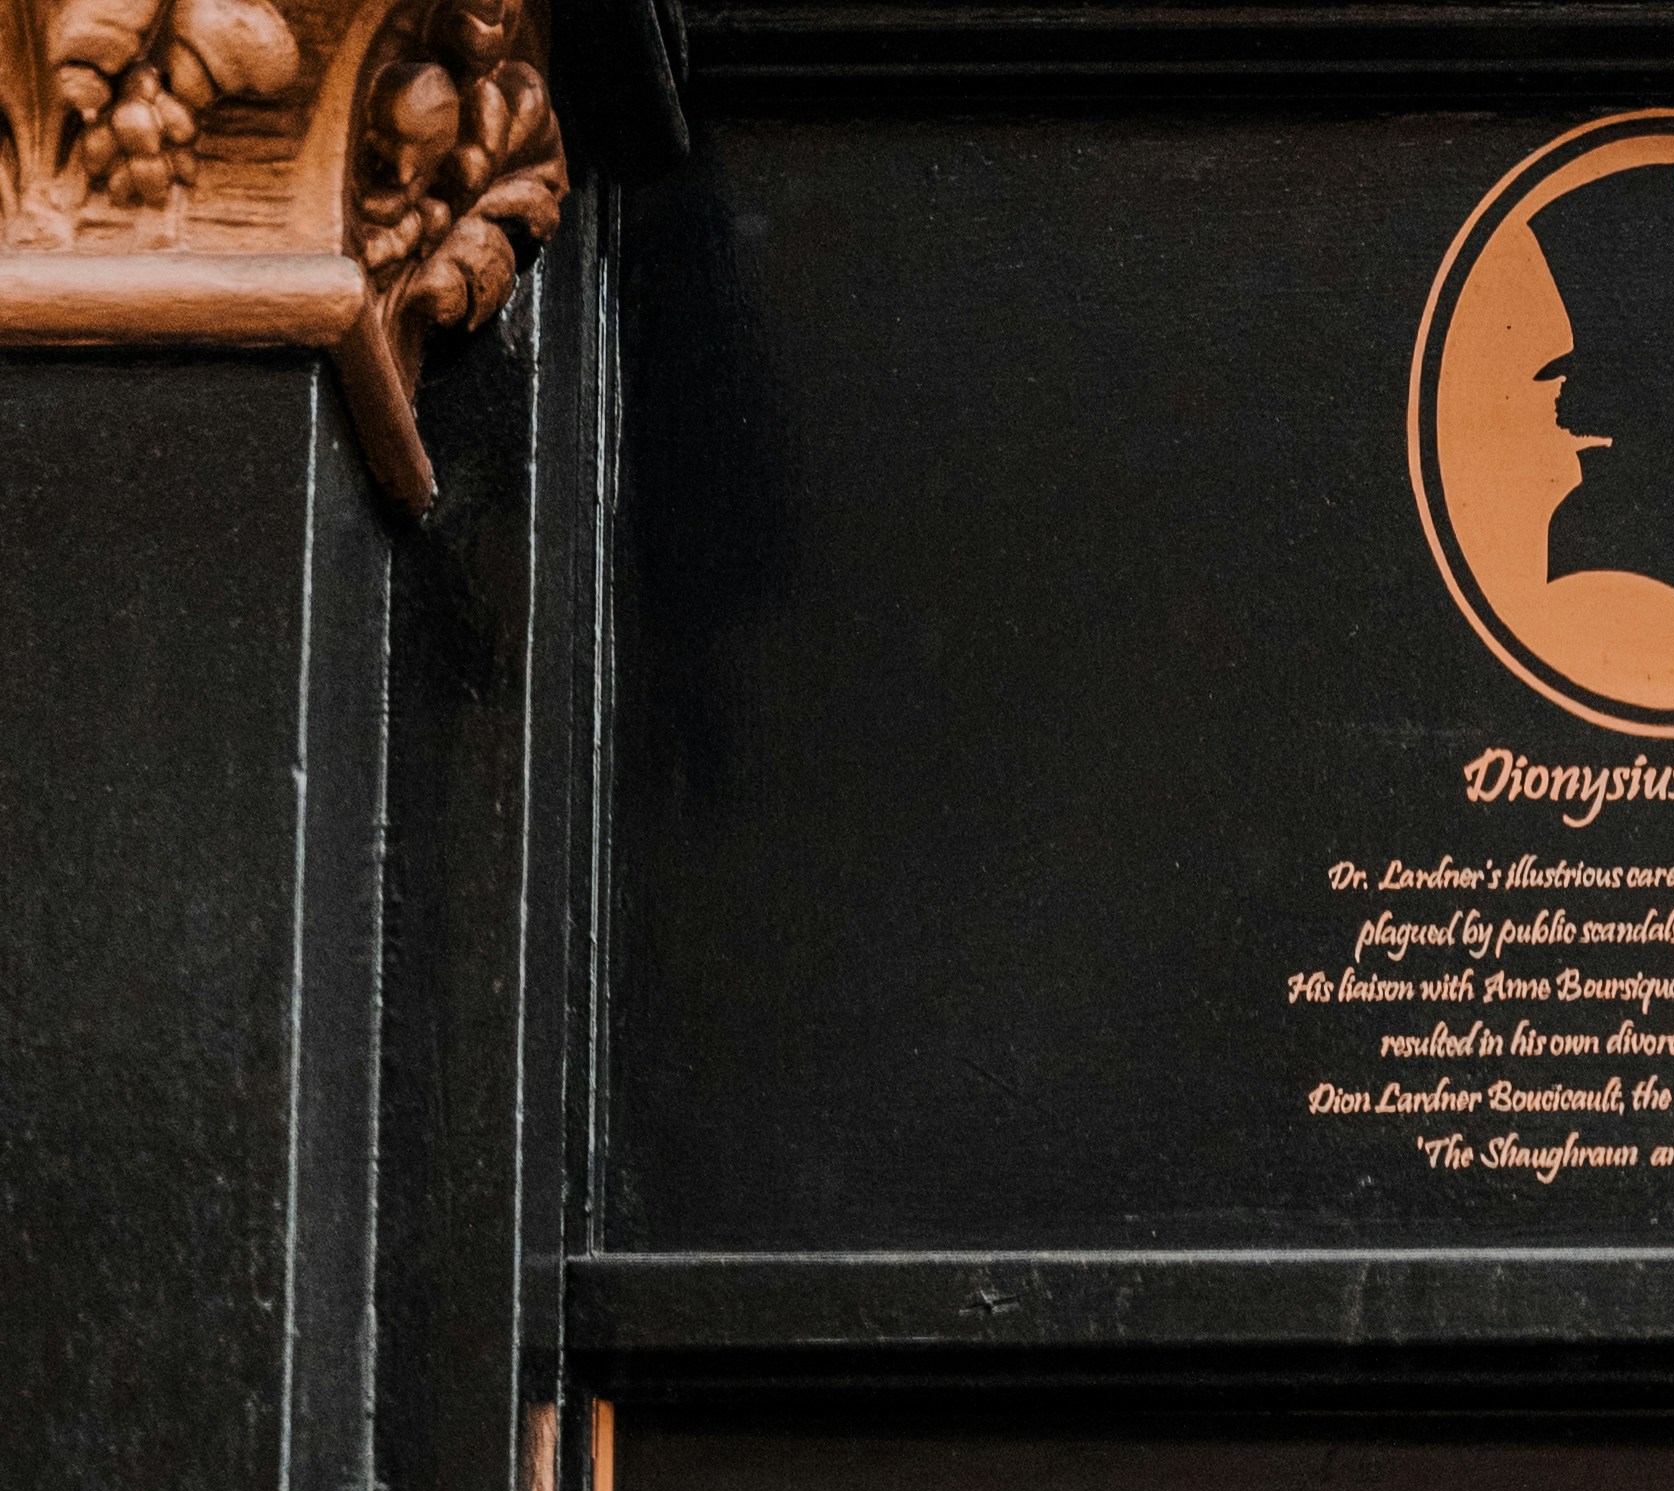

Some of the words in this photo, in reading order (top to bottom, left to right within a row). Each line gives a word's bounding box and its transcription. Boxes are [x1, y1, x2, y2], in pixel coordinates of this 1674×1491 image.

[1328, 861, 1368, 889] Dr.
[1378, 855, 1501, 890] Lardner's
[1505, 854, 1623, 889] illustrious
[1355, 910, 1462, 963] plagued
[1462, 909, 1493, 959] by
[1495, 909, 1577, 958] public
[1288, 971, 1334, 1003] His
[1338, 967, 1414, 1002] liaison
[1420, 968, 1474, 1001] with
[1483, 970, 1551, 1003] Anne
[1381, 1021, 1478, 1057] resulted
[1479, 1029, 1503, 1056] in
[1510, 1020, 1547, 1056] his
[1550, 1035, 1599, 1056] own
[1309, 1083, 1371, 1114] Dion
[1375, 1077, 1482, 1113] Lardner
[1632, 1075, 1672, 1110] the
